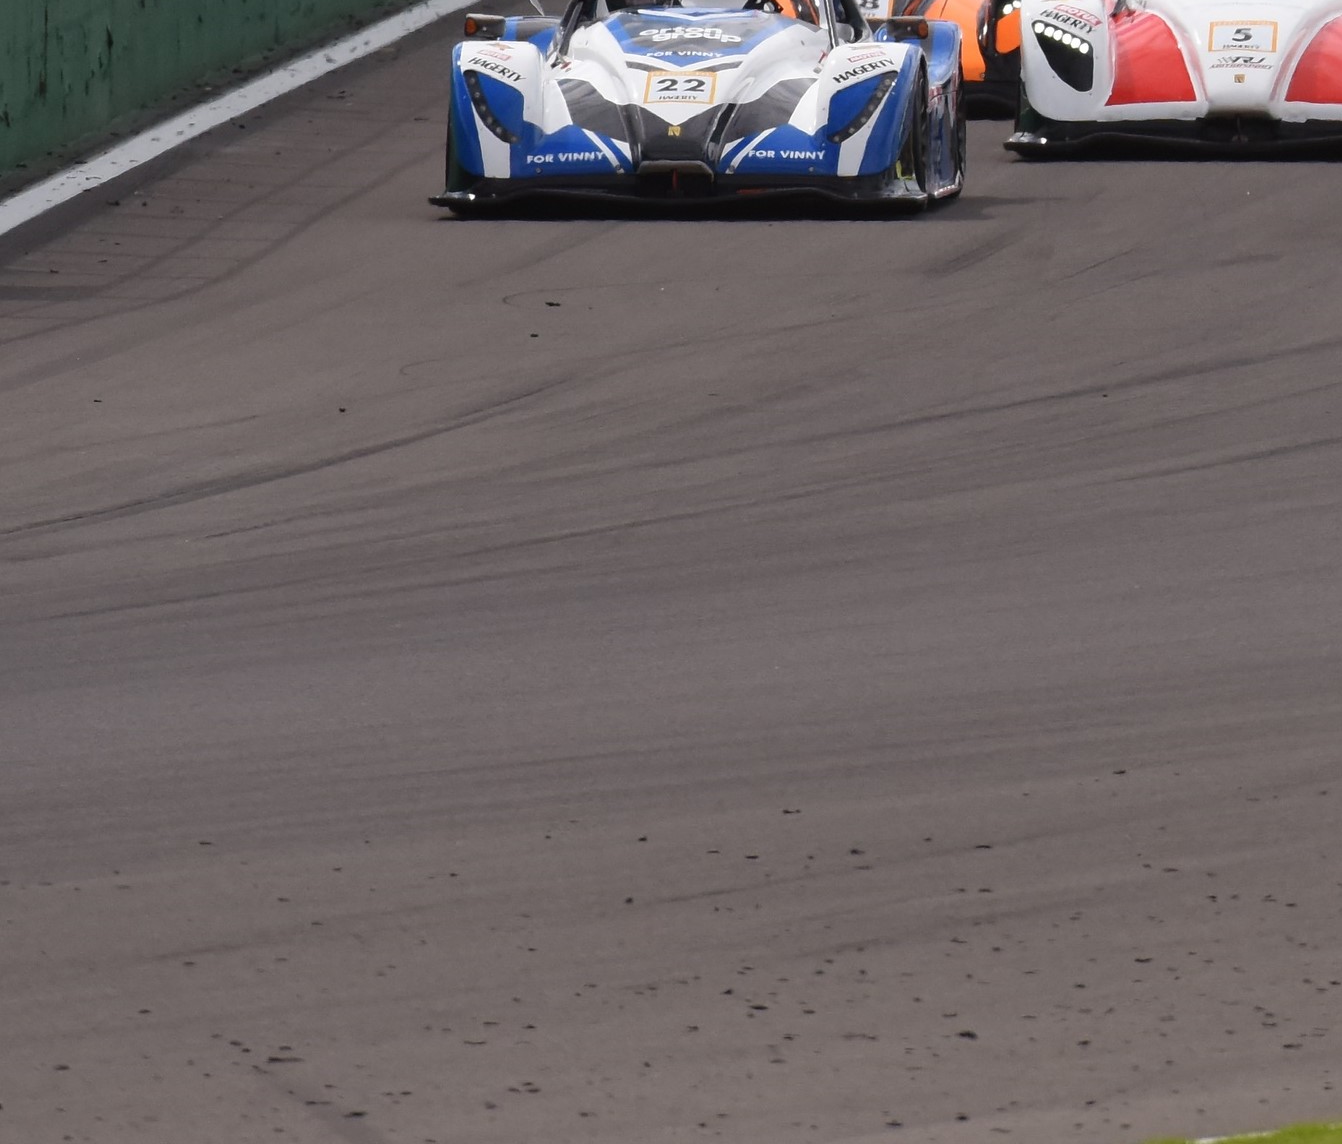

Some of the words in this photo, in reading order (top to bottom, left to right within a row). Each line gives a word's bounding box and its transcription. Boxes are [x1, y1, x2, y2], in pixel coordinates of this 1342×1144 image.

[652, 32, 743, 43] group
[1231, 28, 1253, 42] 5
[468, 57, 526, 82] HAGERTY
[832, 58, 895, 83] HAGERTY
[656, 78, 706, 93] 22
[526, 154, 554, 164] FOR
[559, 151, 606, 162] VINNY
[749, 150, 776, 159] FOR
[780, 150, 826, 160] VINNY
